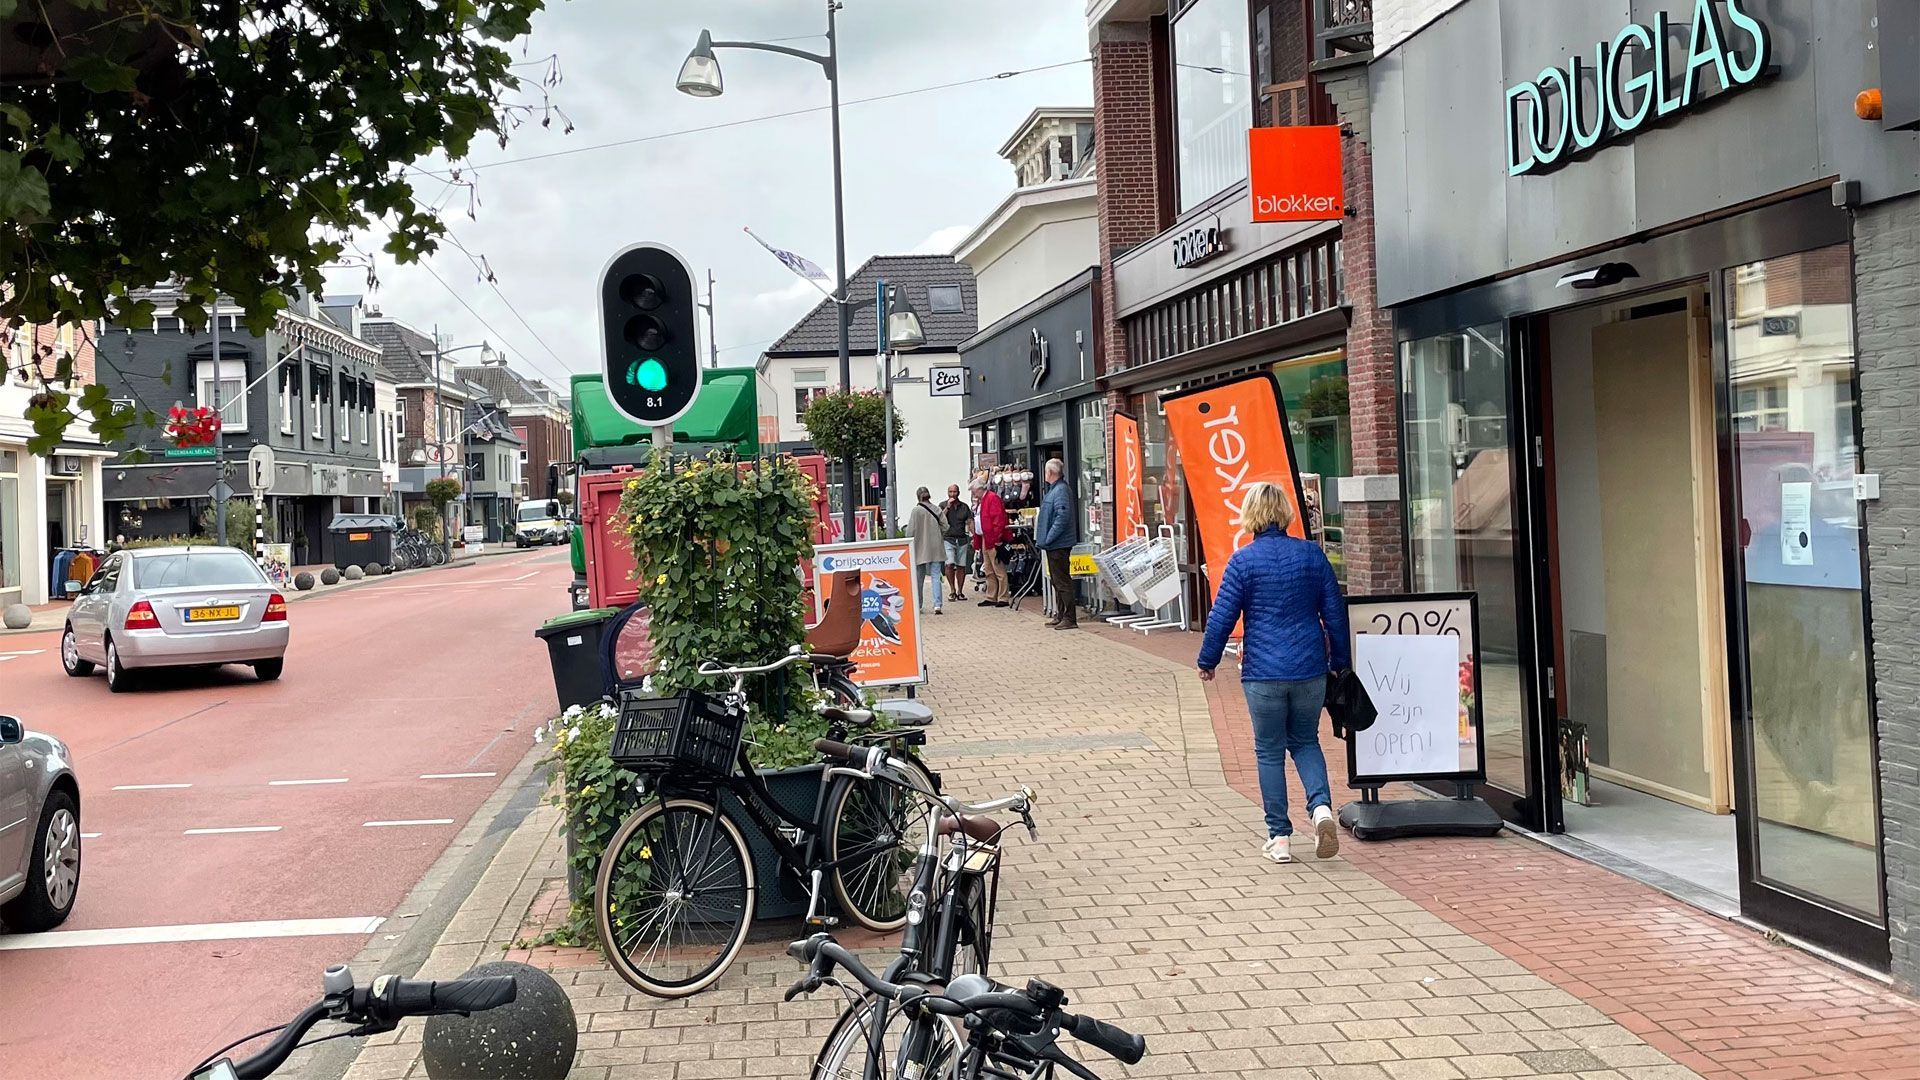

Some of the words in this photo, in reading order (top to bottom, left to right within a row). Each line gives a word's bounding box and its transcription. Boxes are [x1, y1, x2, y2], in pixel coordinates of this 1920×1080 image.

[1506, 0, 1768, 177] DOUGLAS
[936, 371, 961, 386] Etos
[646, 396, 663, 407] 8.1
[861, 596, 880, 608] 5%
[1367, 656, 1412, 696] Wij
[1389, 702, 1424, 725] zijn
[1374, 730, 1432, 757] OPEN!
